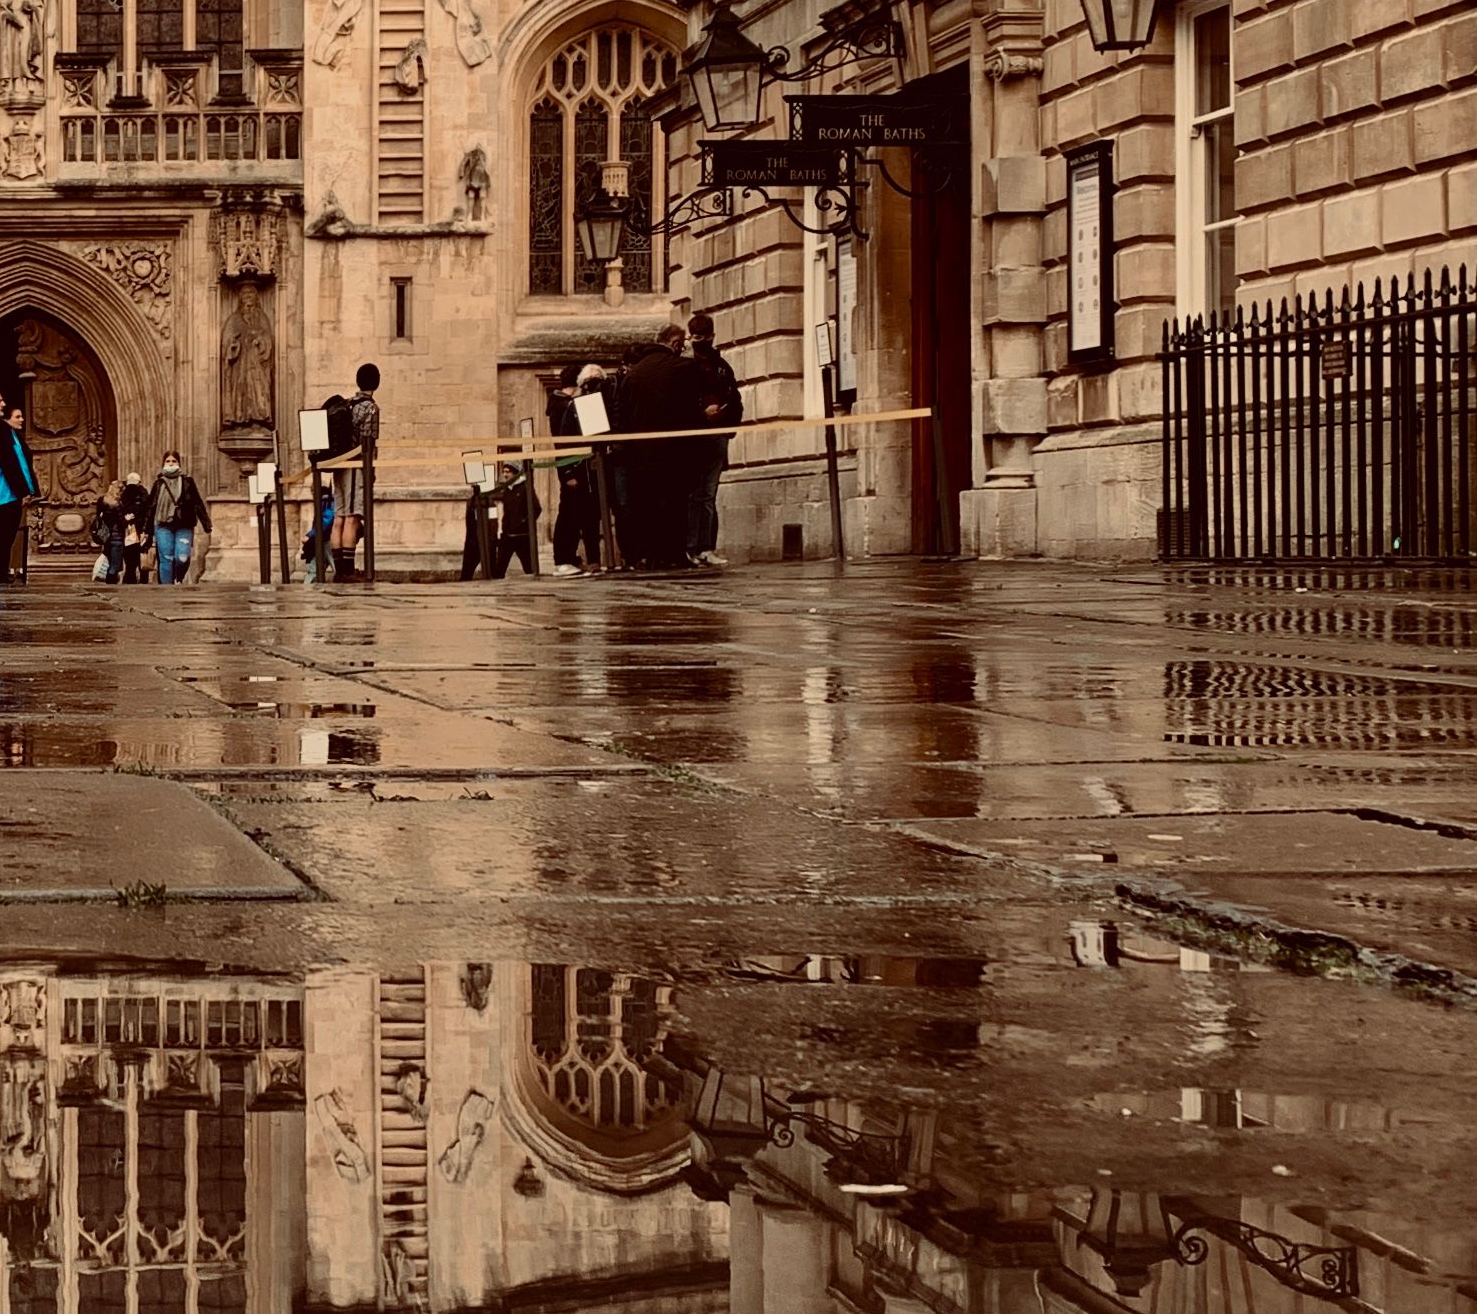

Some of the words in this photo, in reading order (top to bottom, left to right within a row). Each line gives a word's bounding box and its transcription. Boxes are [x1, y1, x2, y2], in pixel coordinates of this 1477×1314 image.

[859, 114, 885, 127] THE
[818, 128, 872, 140] ROMAN
[884, 128, 926, 140] BATHS
[766, 157, 788, 168] THE
[726, 169, 777, 181] ROMAN
[790, 169, 827, 181] BATHS
